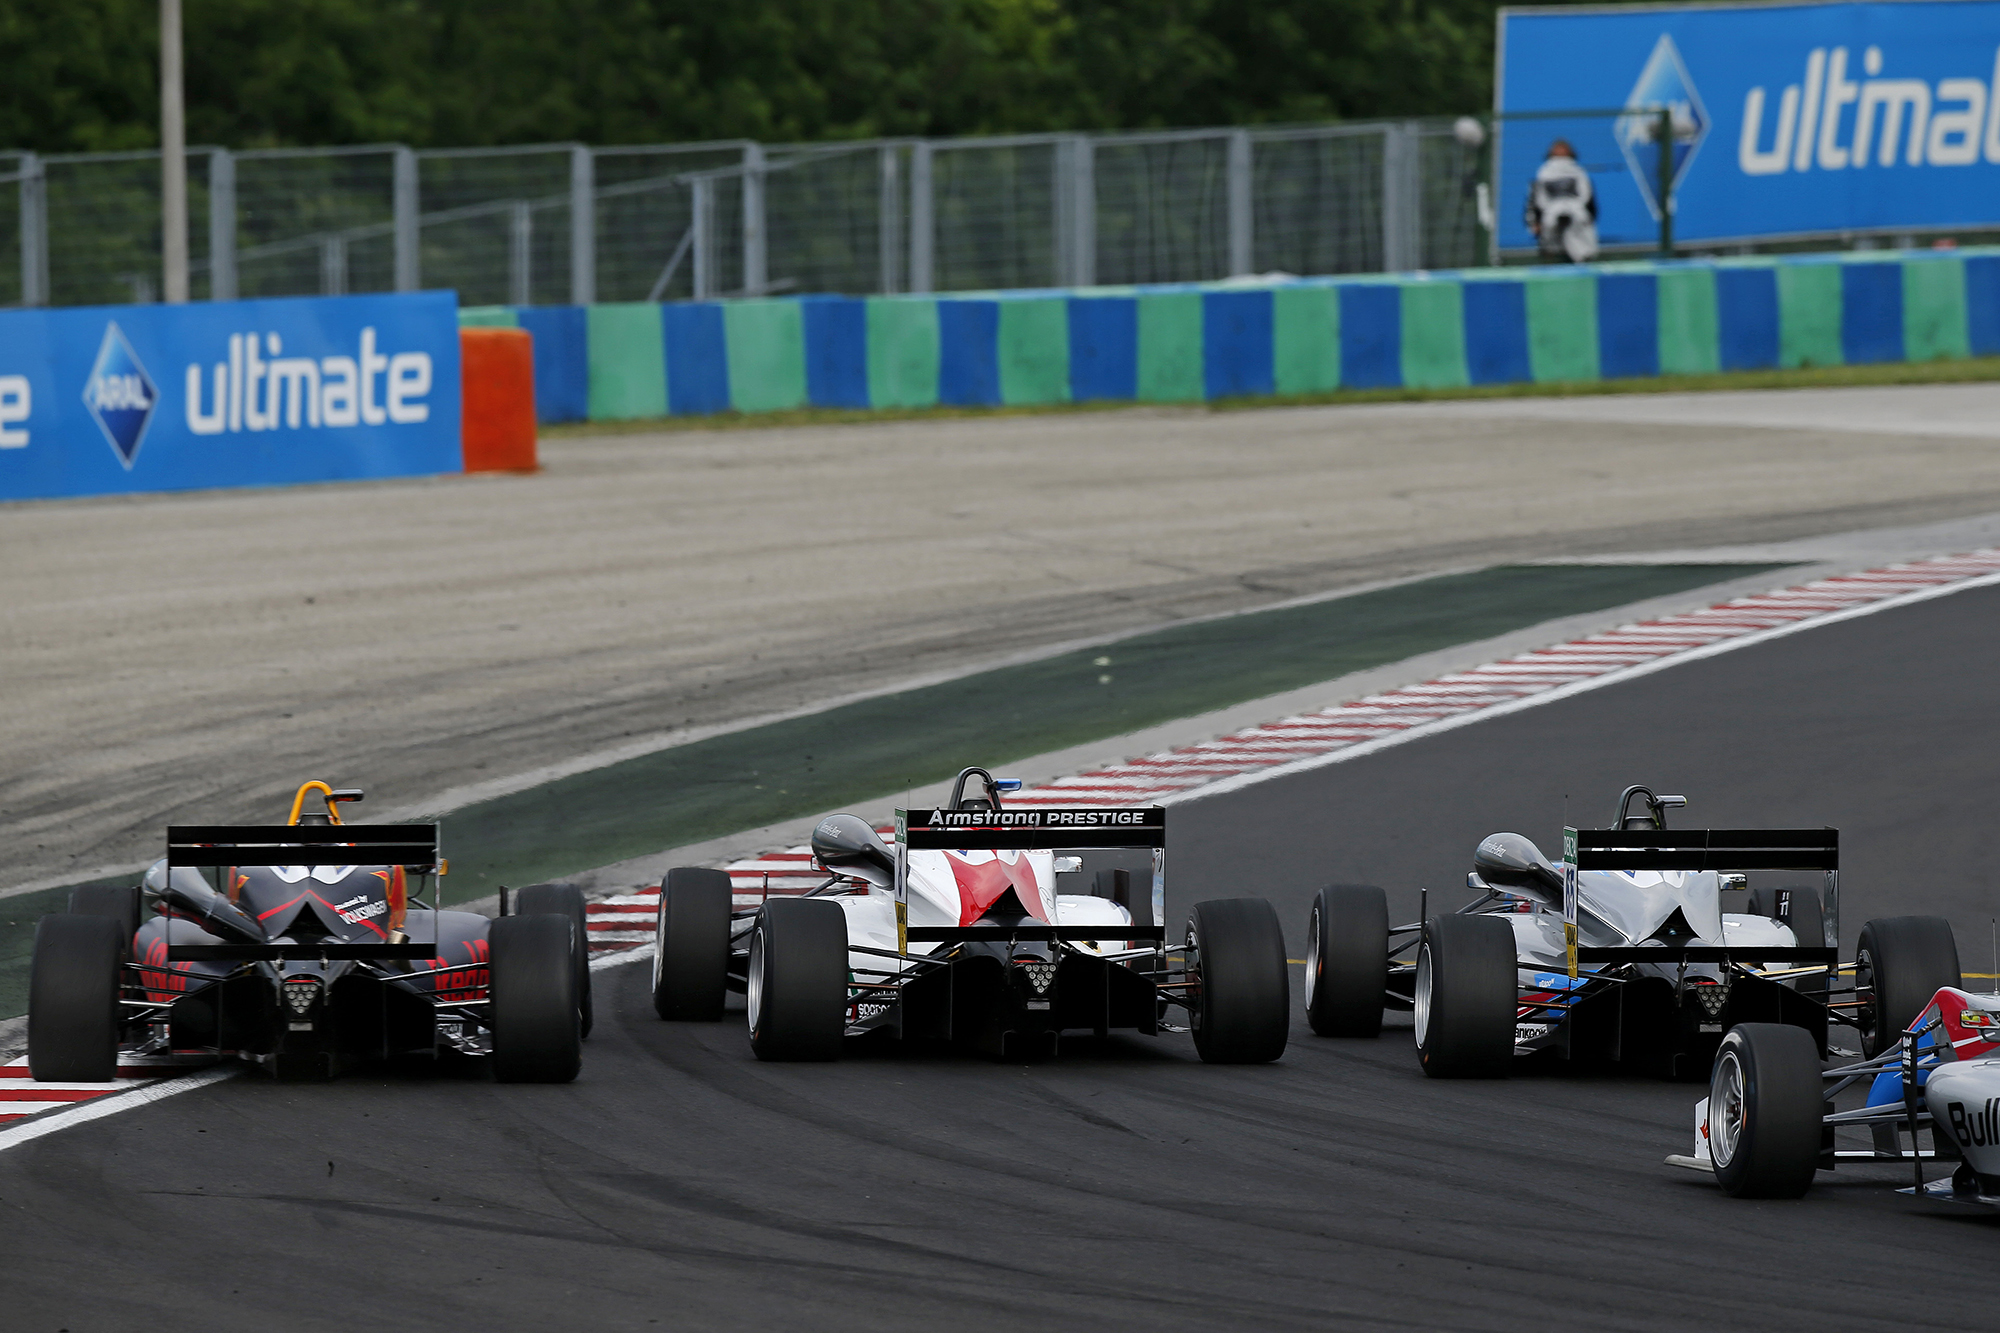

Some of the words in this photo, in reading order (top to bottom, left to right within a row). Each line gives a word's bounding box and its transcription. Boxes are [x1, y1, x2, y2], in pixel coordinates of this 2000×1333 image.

[185, 326, 432, 436] ultimate
[928, 809, 1040, 827] Armstrong
[1046, 811, 1145, 825] PRESTIGE
